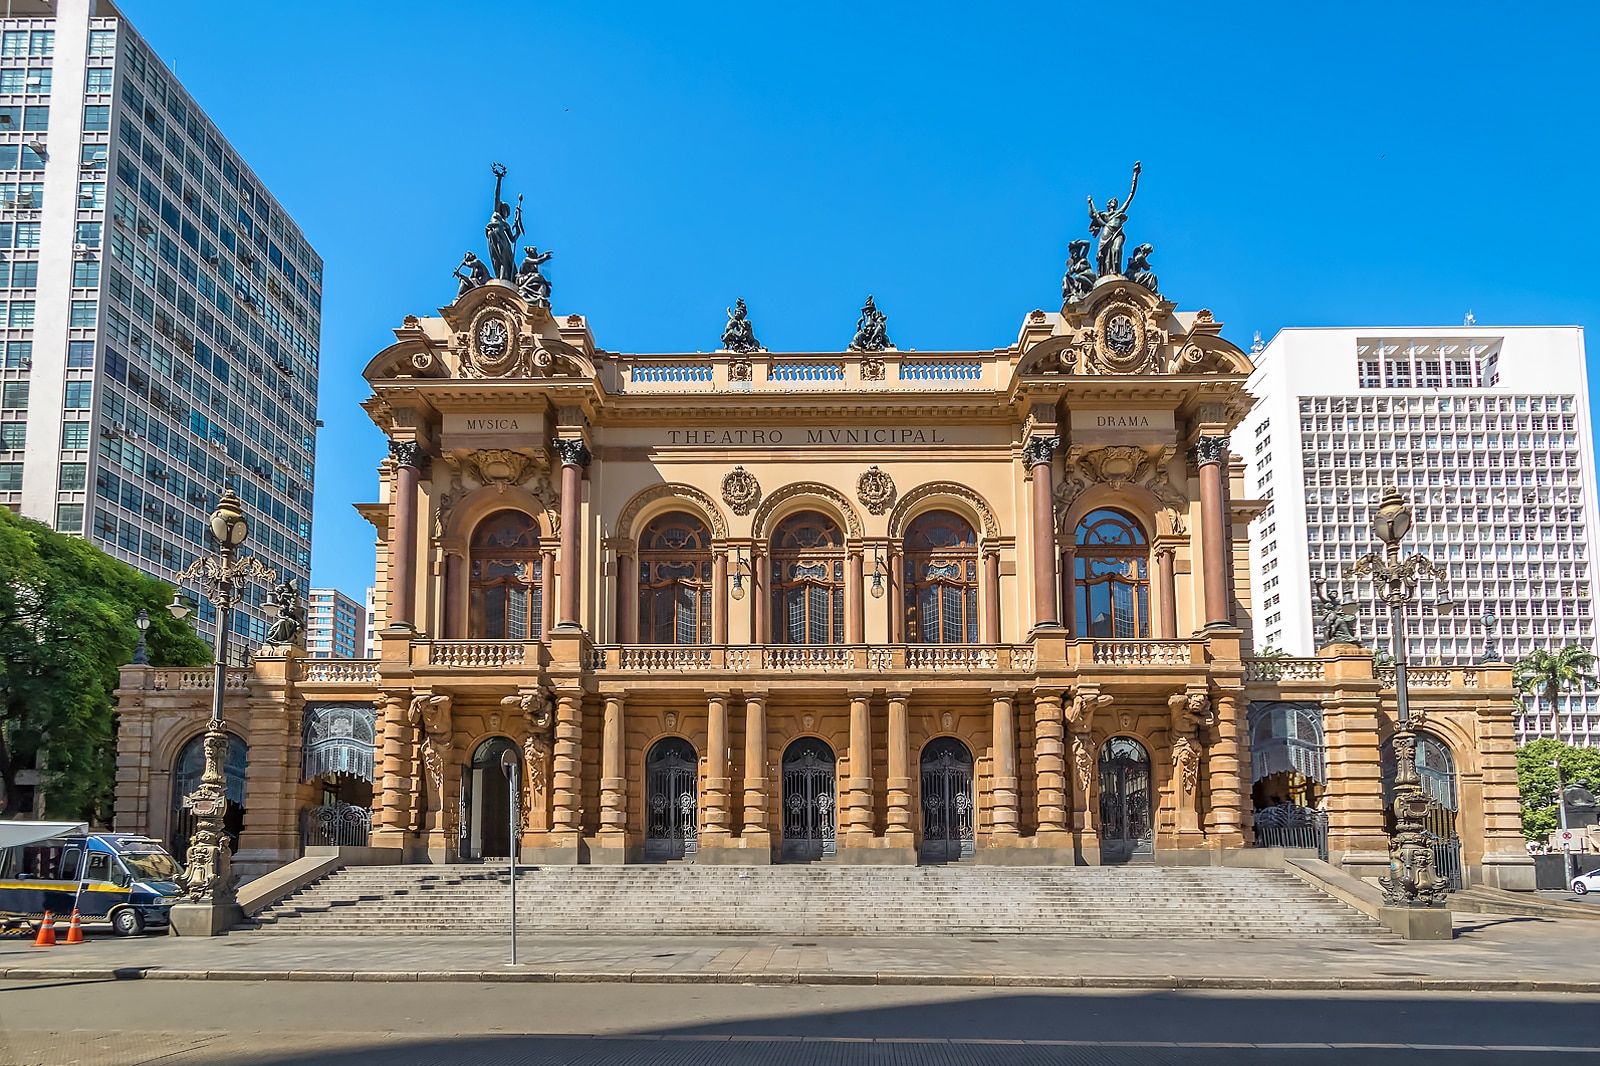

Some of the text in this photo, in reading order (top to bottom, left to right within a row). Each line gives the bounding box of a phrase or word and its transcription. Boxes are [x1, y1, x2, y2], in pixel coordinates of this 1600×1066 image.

[467, 419, 519, 430] MVSICA
[1096, 415, 1149, 427] DRAMA
[667, 429, 946, 444] THEATRO MVNICIPAL
